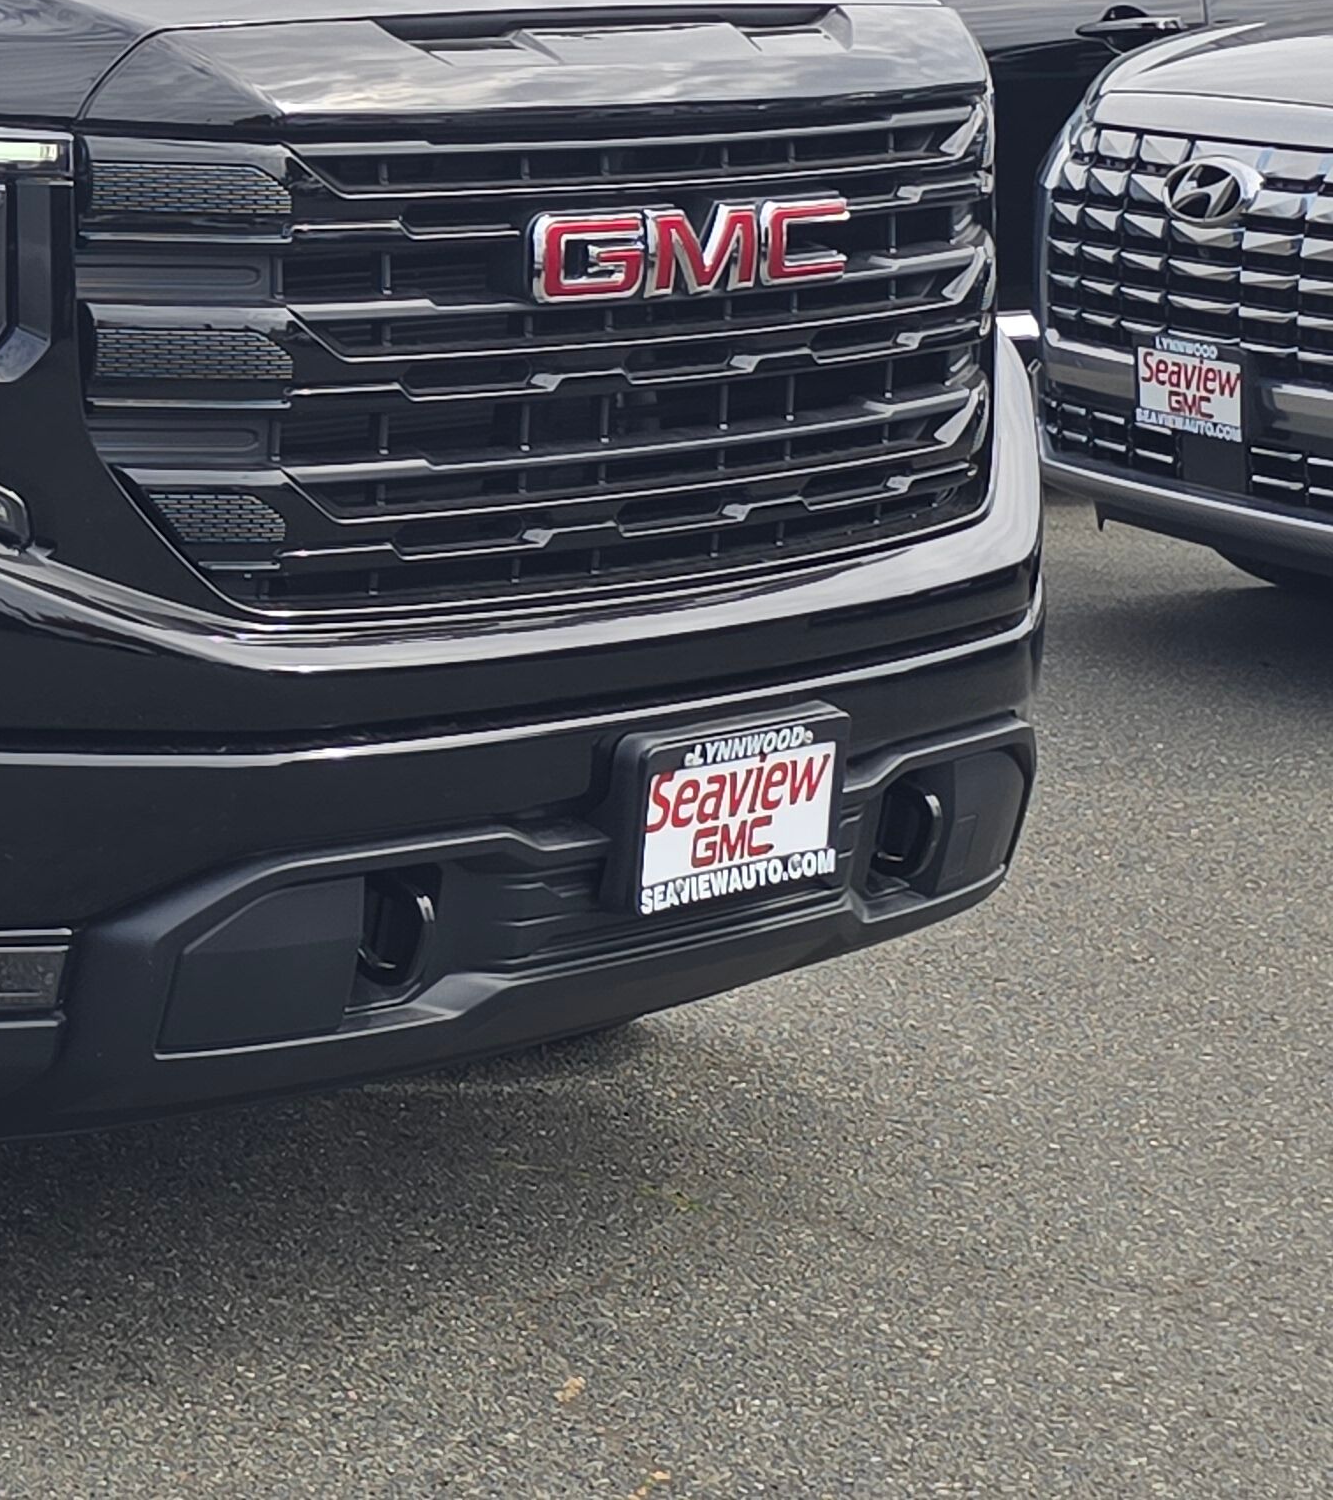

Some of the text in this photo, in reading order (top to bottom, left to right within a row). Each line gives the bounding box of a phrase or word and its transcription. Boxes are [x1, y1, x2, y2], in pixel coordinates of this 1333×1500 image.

[533, 198, 851, 303] GMC
[1141, 351, 1242, 398] Seaview
[1168, 389, 1214, 420] GMC
[691, 725, 807, 767] LYNNWOOD
[644, 751, 832, 834] Seaview
[690, 814, 774, 869] GMC
[639, 847, 837, 916] SEAVIEWAUTO.COM
